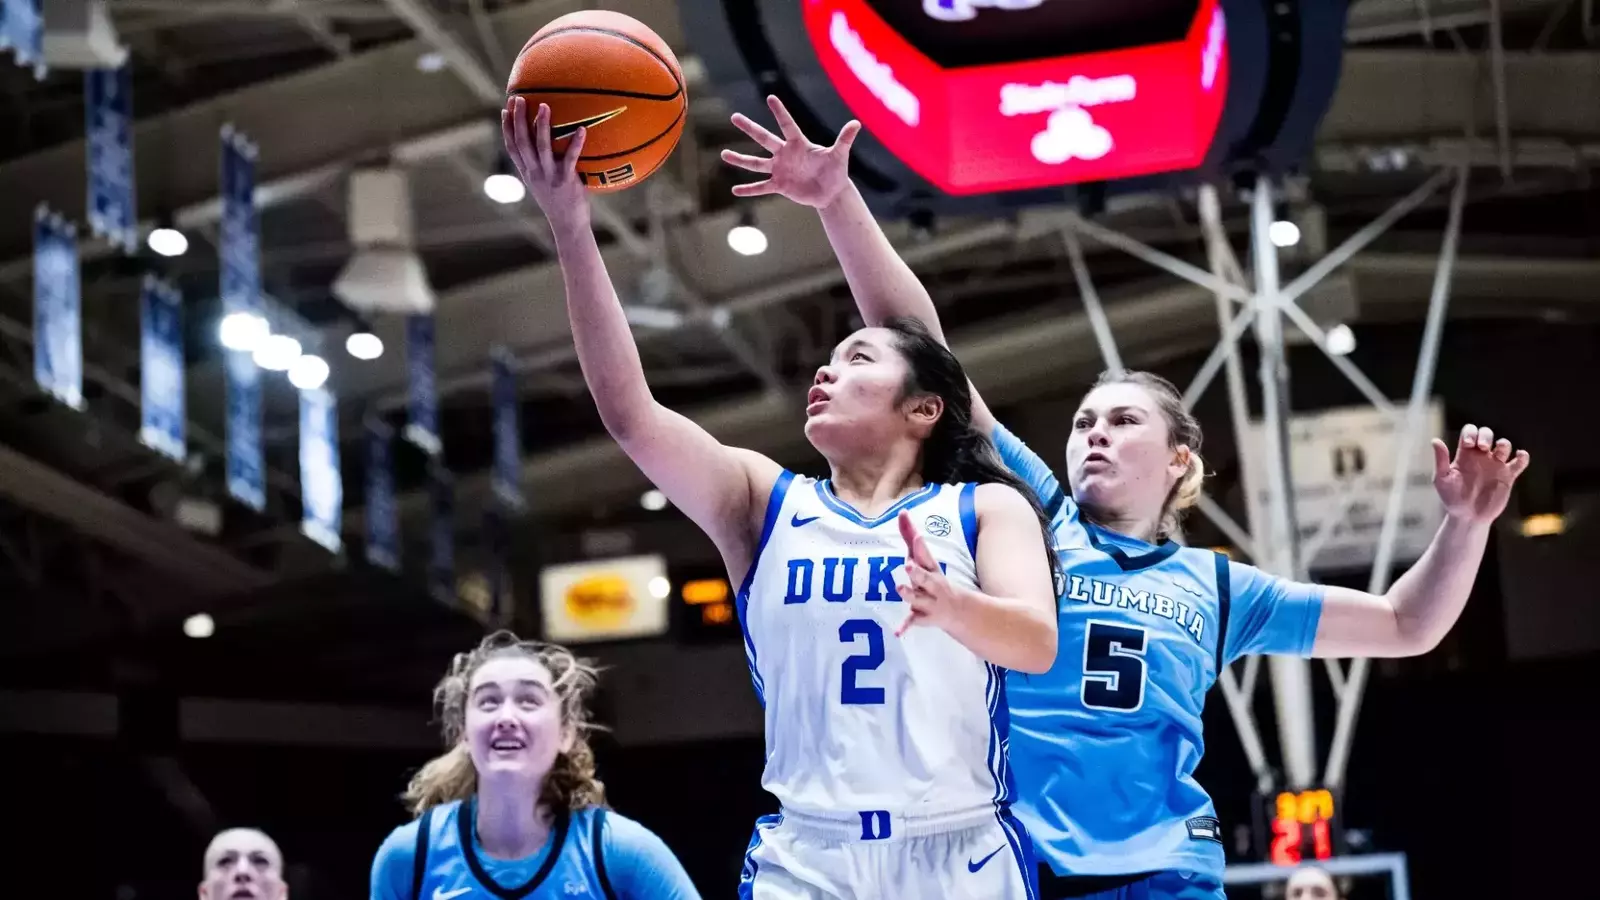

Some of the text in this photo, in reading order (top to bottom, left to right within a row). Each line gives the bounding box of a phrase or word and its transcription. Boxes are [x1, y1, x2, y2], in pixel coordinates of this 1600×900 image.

[784, 556, 947, 605] DUK
[1054, 571, 1205, 643] OLUMBIA
[838, 618, 886, 705] 2
[1080, 618, 1149, 713] 5
